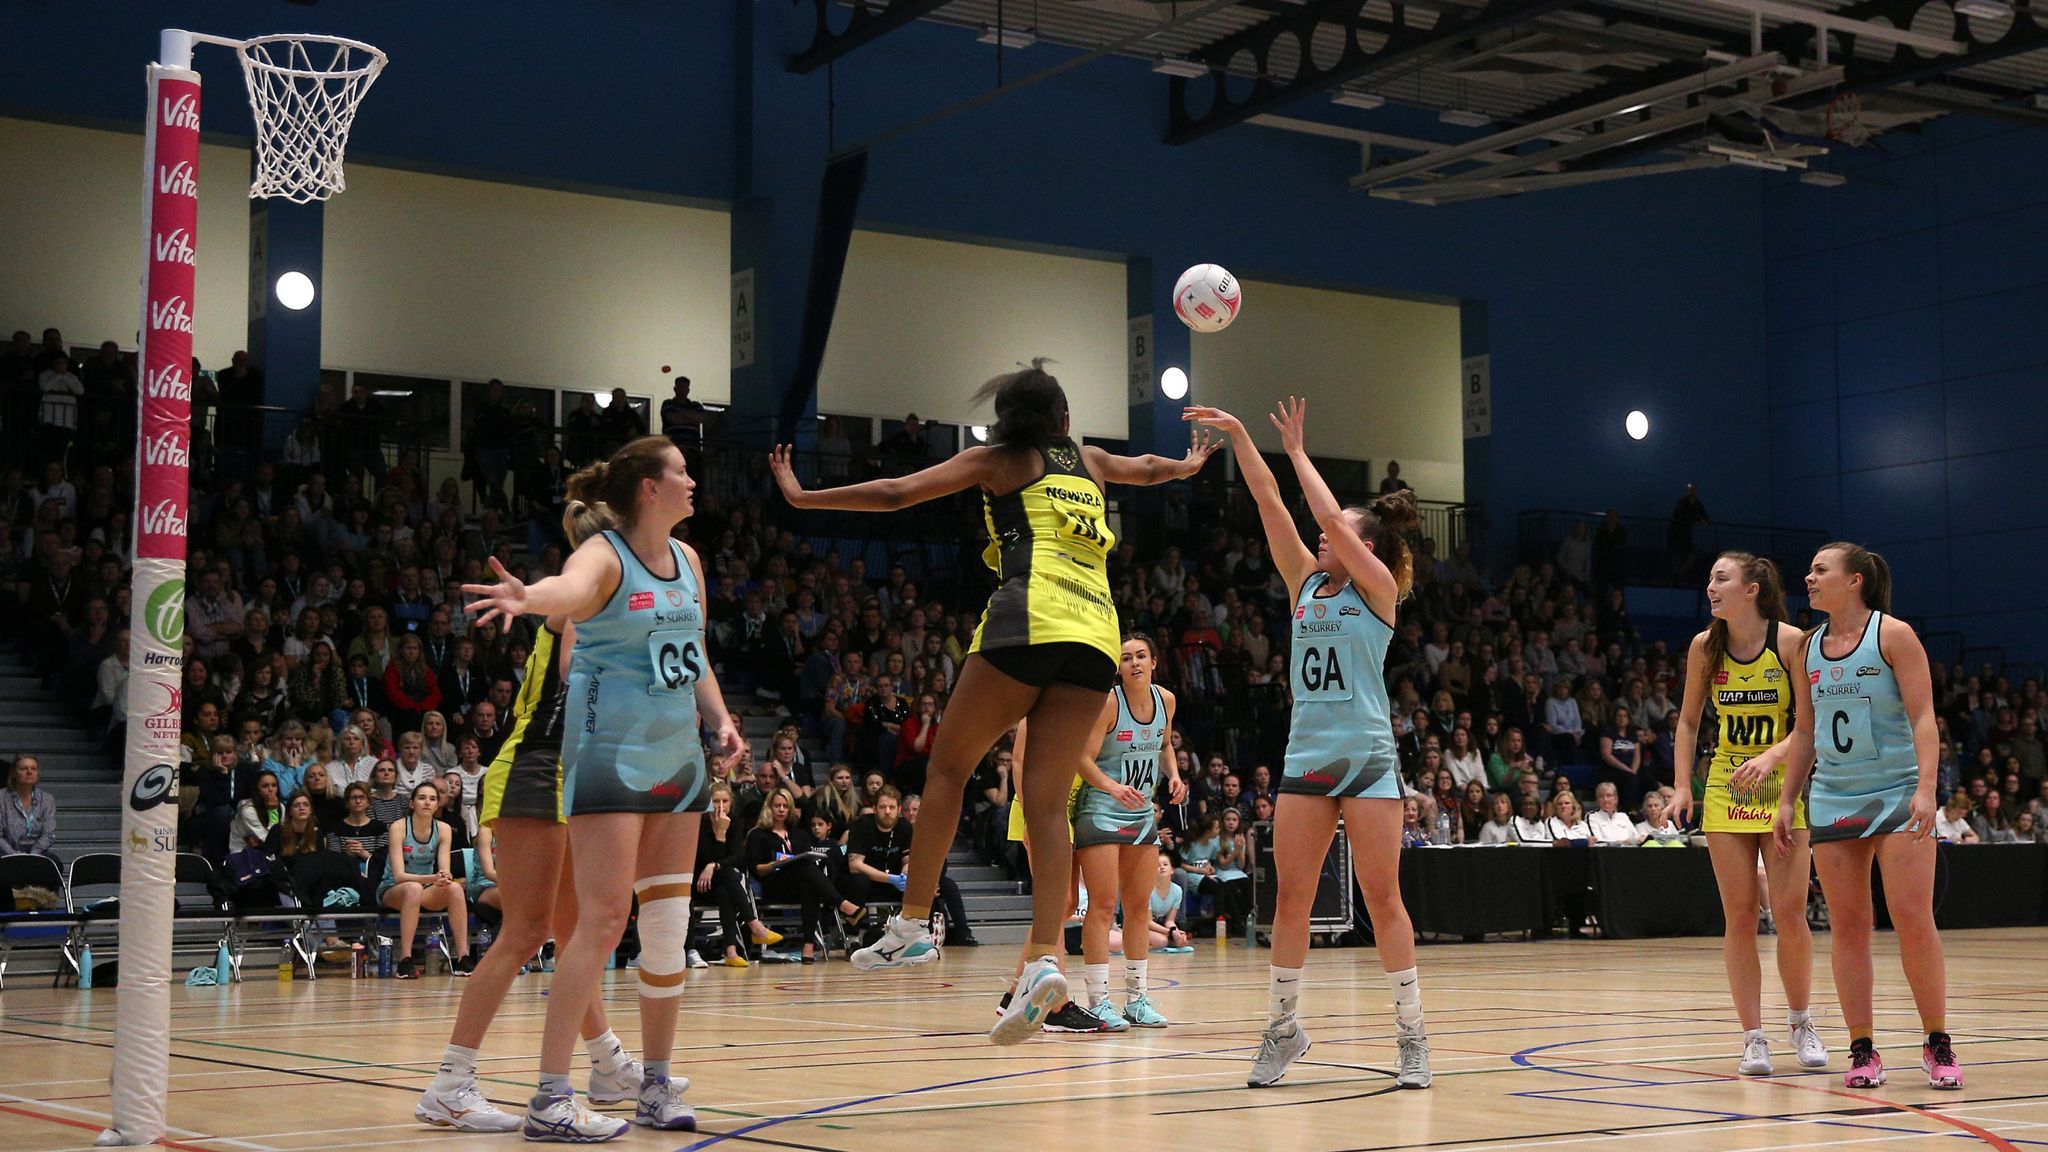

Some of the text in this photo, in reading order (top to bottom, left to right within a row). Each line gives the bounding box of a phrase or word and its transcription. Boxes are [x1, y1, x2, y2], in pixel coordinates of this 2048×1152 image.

[736, 292, 748, 316] A
[1136, 335, 1145, 357] B
[1470, 374, 1481, 395] B
[1046, 487, 1102, 510] NGWIRA
[667, 611, 698, 623] SURREY
[1309, 624, 1342, 633] SURREY
[659, 642, 700, 690] GS
[1301, 646, 1346, 691] GA
[1746, 690, 1778, 702] fullex
[1827, 686, 1861, 697] SURREY
[1727, 714, 1774, 746] WD
[1832, 710, 1854, 753] C
[1125, 759, 1154, 791] WA
[1728, 805, 1773, 827] Vitality
[154, 835, 175, 852] SU
